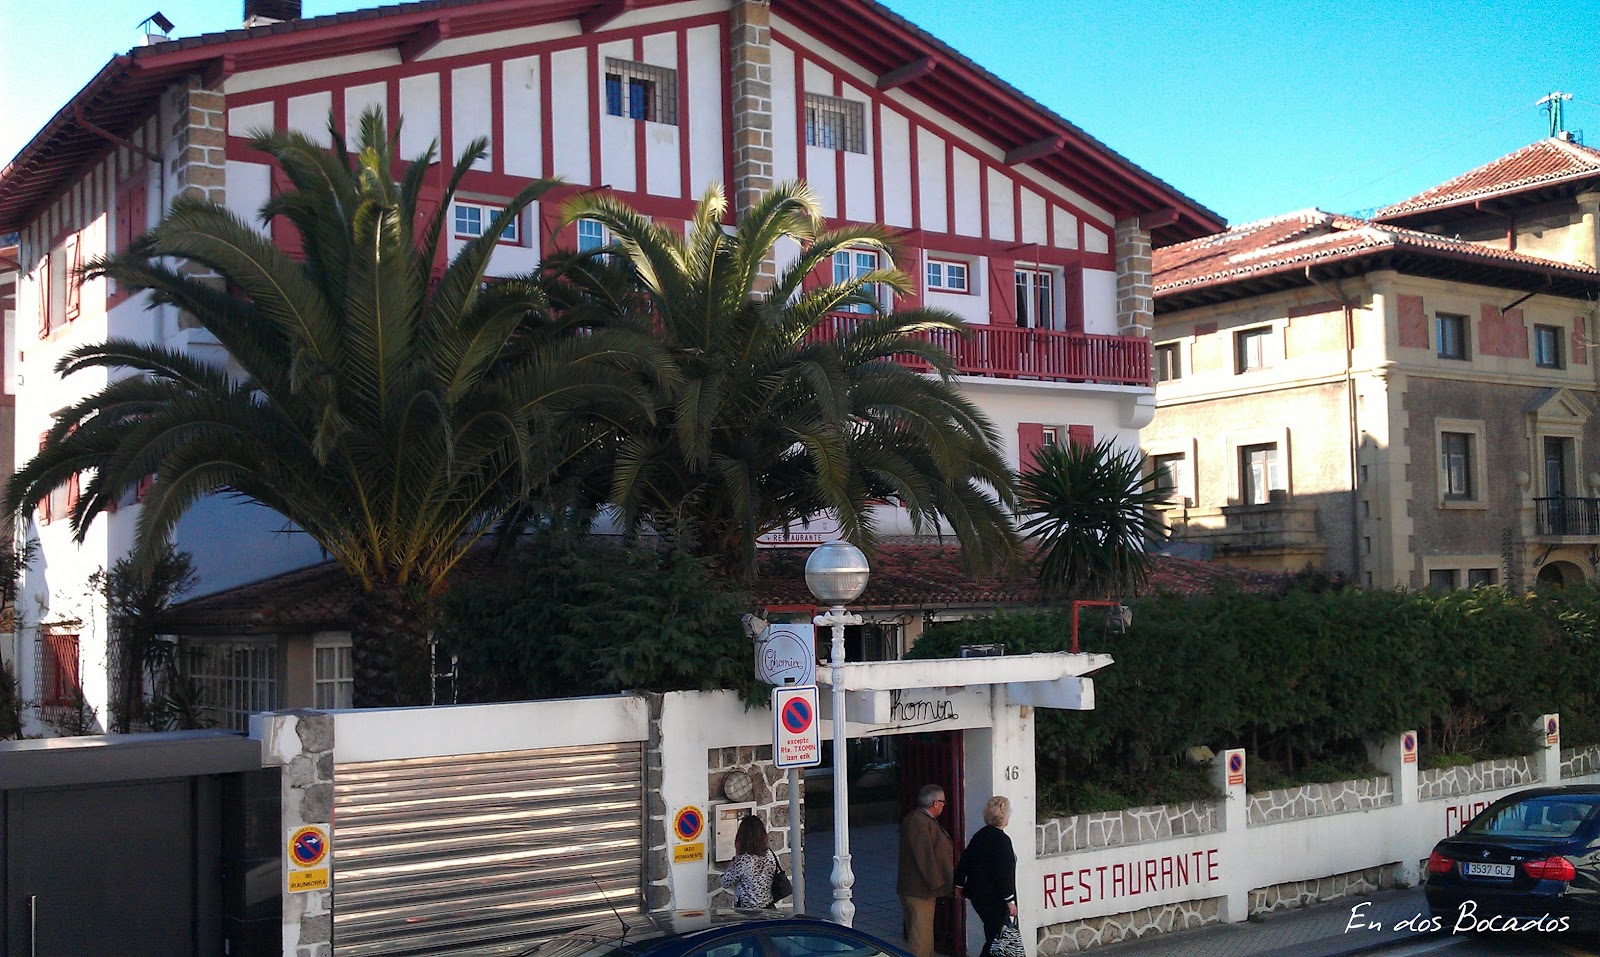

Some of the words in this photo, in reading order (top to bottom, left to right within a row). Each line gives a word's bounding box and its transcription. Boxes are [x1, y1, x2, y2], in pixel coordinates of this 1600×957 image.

[774, 534, 822, 542] RESTAURANTE
[889, 689, 959, 723] homin
[780, 746, 792, 754] Rte.
[794, 744, 816, 752] TXOMIN
[800, 752, 811, 760] ezik
[1005, 765, 1019, 781] 16
[1471, 864, 1492, 875] 3537
[1495, 865, 1512, 876] GLZ
[1043, 849, 1219, 909] RESTAURANTE
